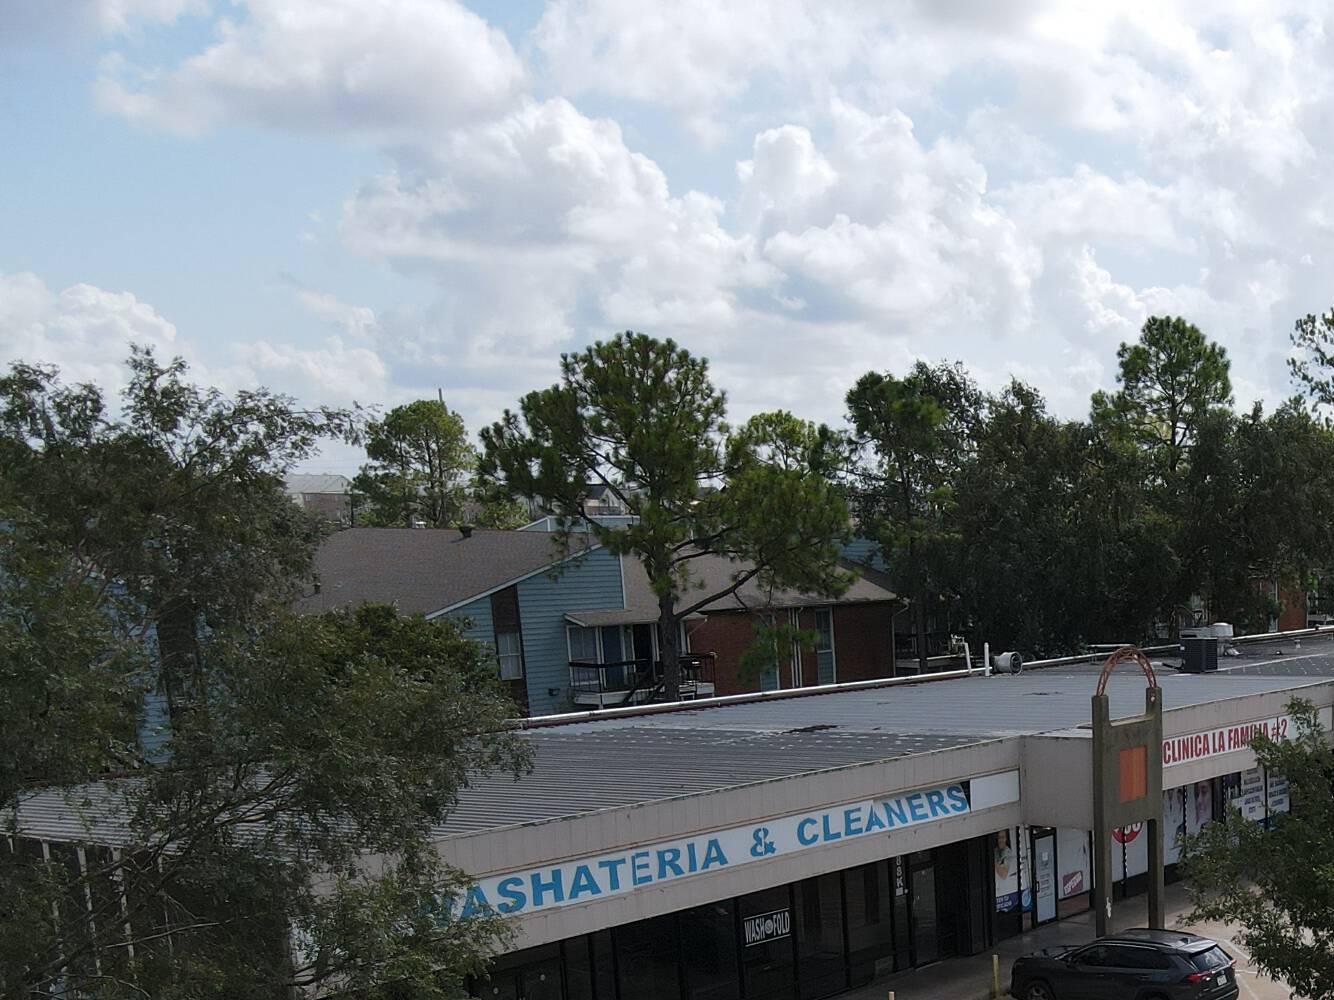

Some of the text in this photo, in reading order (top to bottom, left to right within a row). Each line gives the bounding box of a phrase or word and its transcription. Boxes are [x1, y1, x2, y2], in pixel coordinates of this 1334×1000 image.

[1163, 734, 1211, 764] CLINICA
[1212, 730, 1225, 753] LA
[1271, 718, 1288, 742] #2
[750, 826, 776, 857] &
[796, 785, 970, 847] CLEANERS
[744, 911, 790, 944] WASH FOLD
